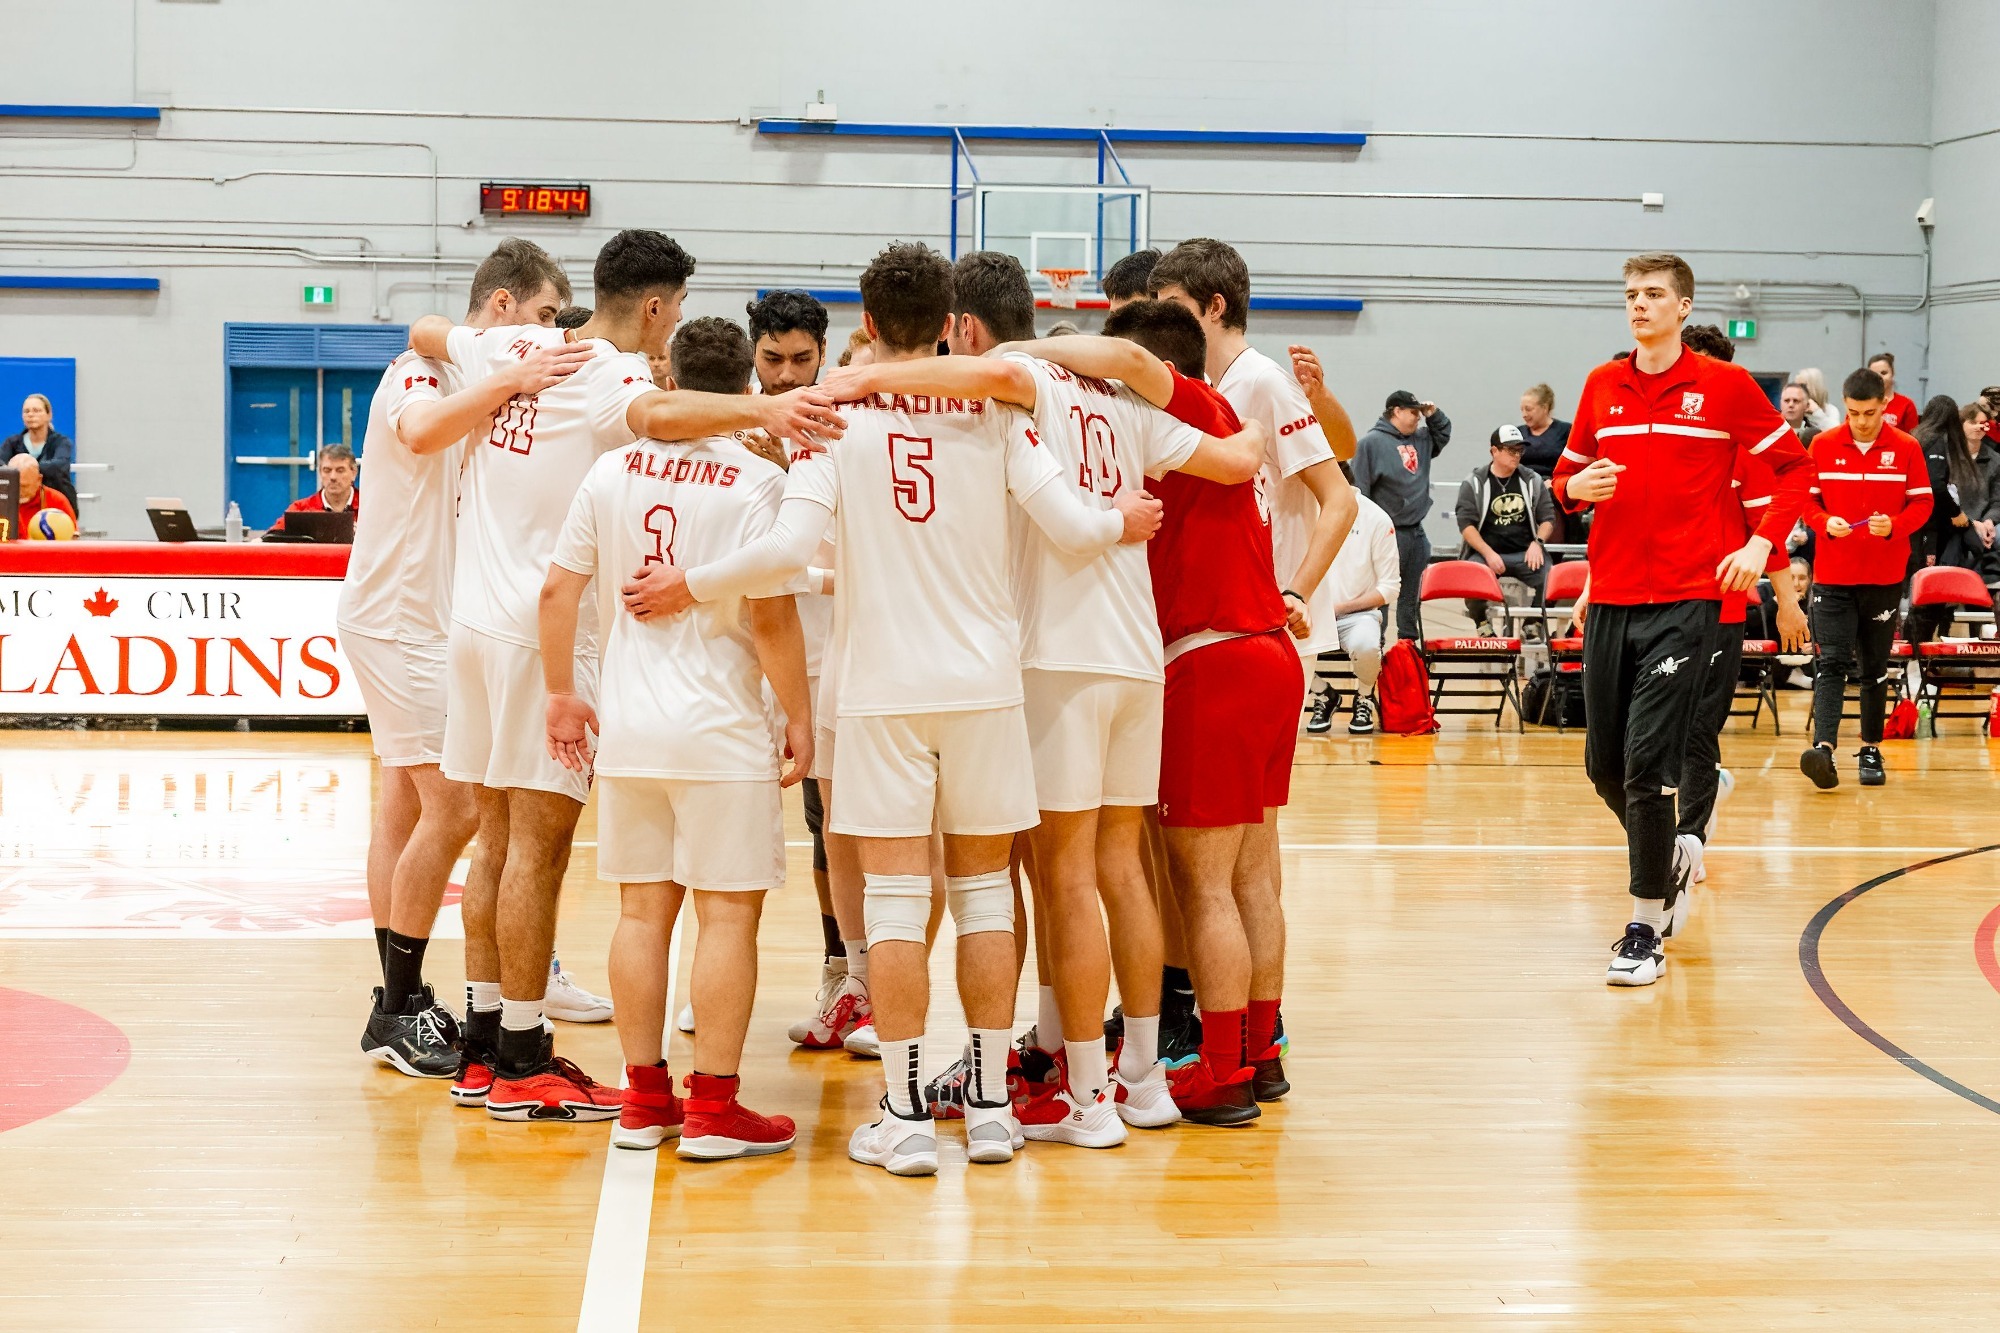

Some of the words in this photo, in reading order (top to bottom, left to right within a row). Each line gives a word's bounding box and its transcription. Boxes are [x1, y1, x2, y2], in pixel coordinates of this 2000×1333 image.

[1280, 414, 1318, 437] OUA
[888, 433, 936, 523] 5
[147, 590, 242, 619] CMR
[1454, 640, 1508, 650] PALADINS
[0, 633, 340, 698] LADINS
